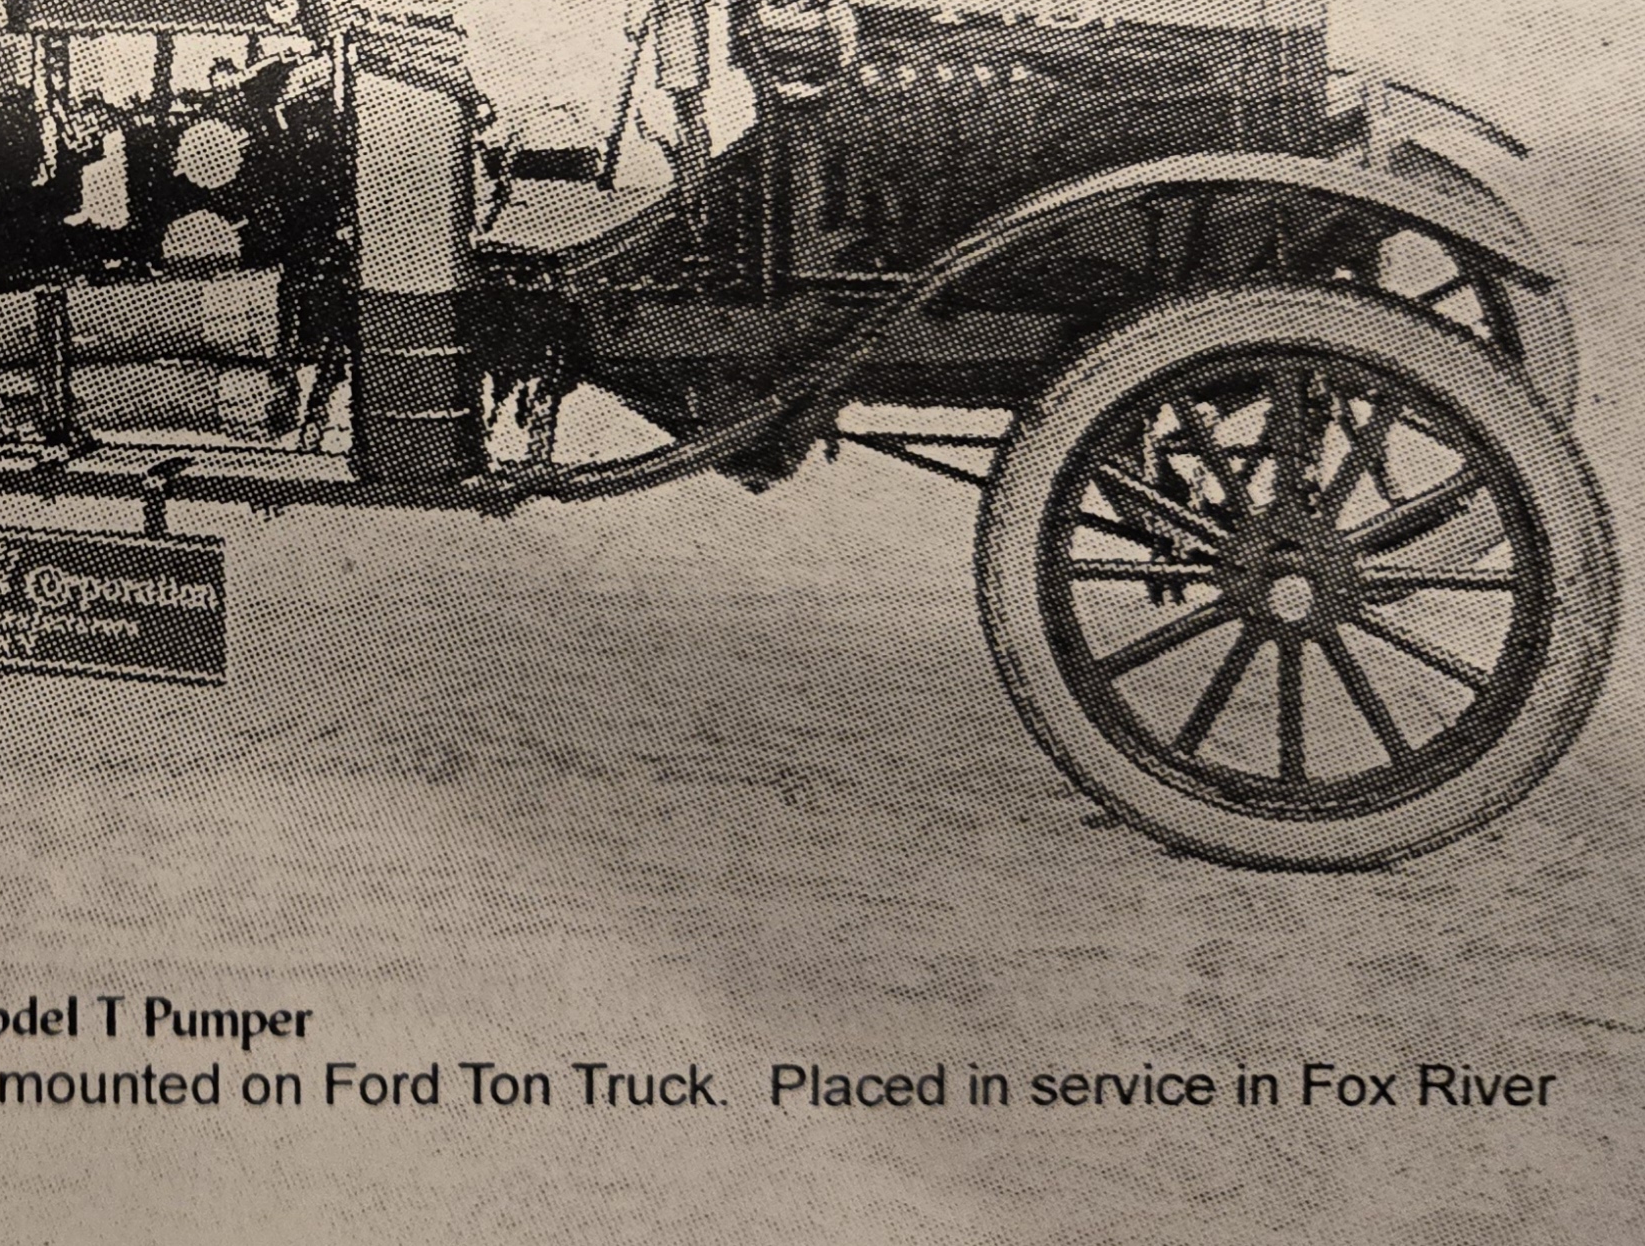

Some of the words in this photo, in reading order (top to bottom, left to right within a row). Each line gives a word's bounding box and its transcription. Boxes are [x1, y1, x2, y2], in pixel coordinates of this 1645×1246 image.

[24, 564, 222, 613] Corporation
[96, 995, 125, 1039] T
[143, 995, 314, 1052] Pumper
[241, 1072, 303, 1107] on
[324, 1062, 441, 1108] Ford
[458, 1062, 552, 1107] Ton
[571, 1062, 728, 1108] Truck.
[770, 1062, 947, 1108] Placed
[969, 1063, 1010, 1107] in
[1030, 1064, 1217, 1108] service
[1236, 1064, 1280, 1108] in
[1302, 1062, 1397, 1108] Fox
[1418, 1062, 1558, 1108] River
